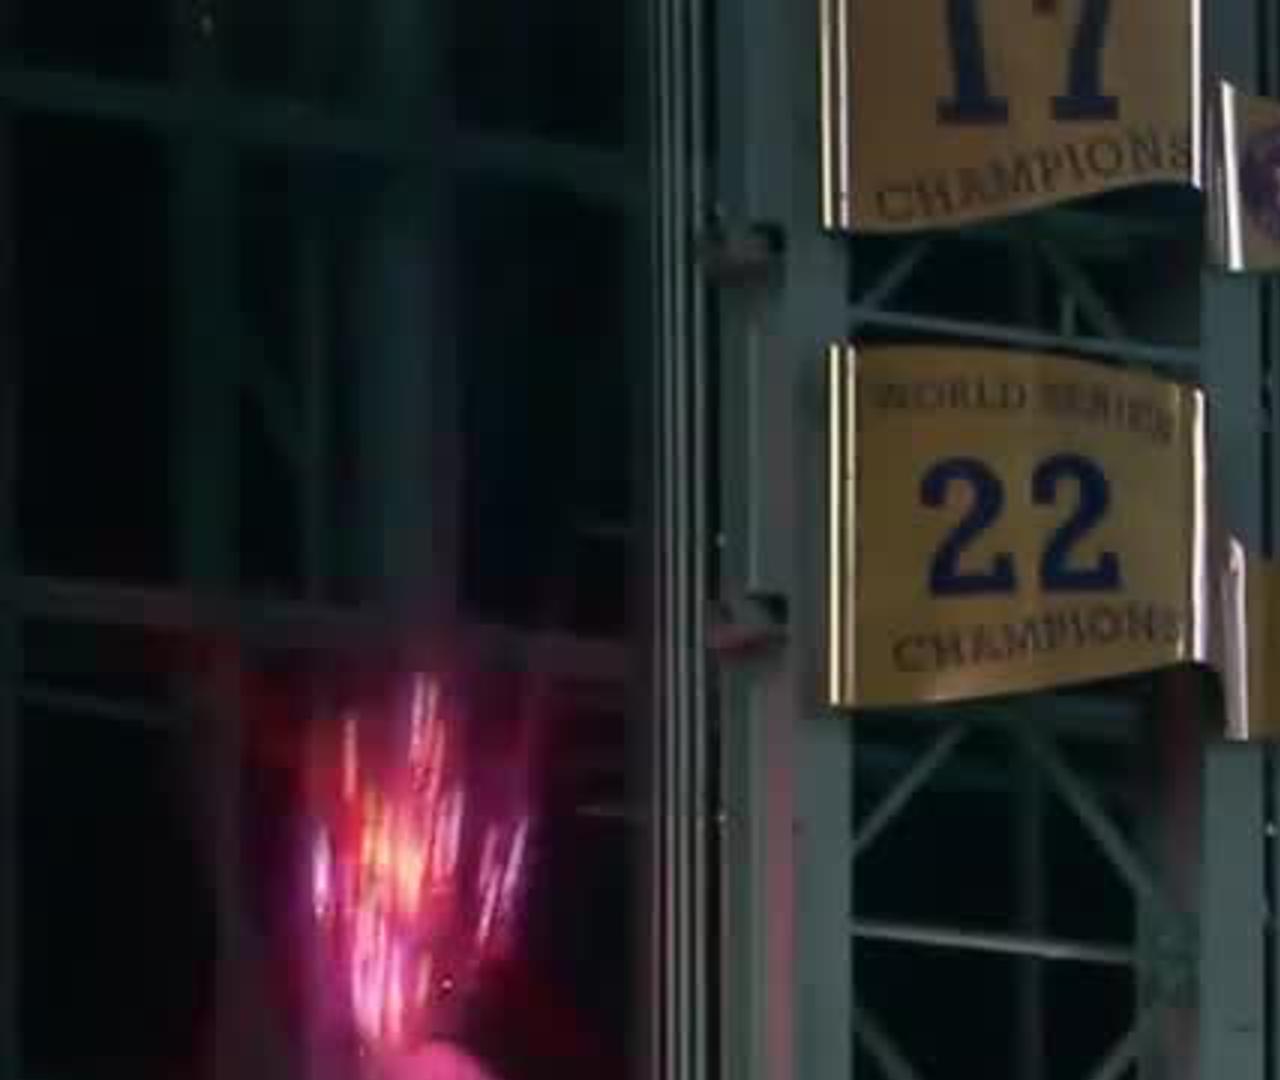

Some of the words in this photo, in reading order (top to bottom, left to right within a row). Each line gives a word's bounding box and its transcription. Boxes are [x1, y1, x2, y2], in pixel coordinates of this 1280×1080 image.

[936, 0, 1118, 126] 17
[875, 126, 1192, 222] CHAMPIONS
[919, 455, 1120, 596] 22
